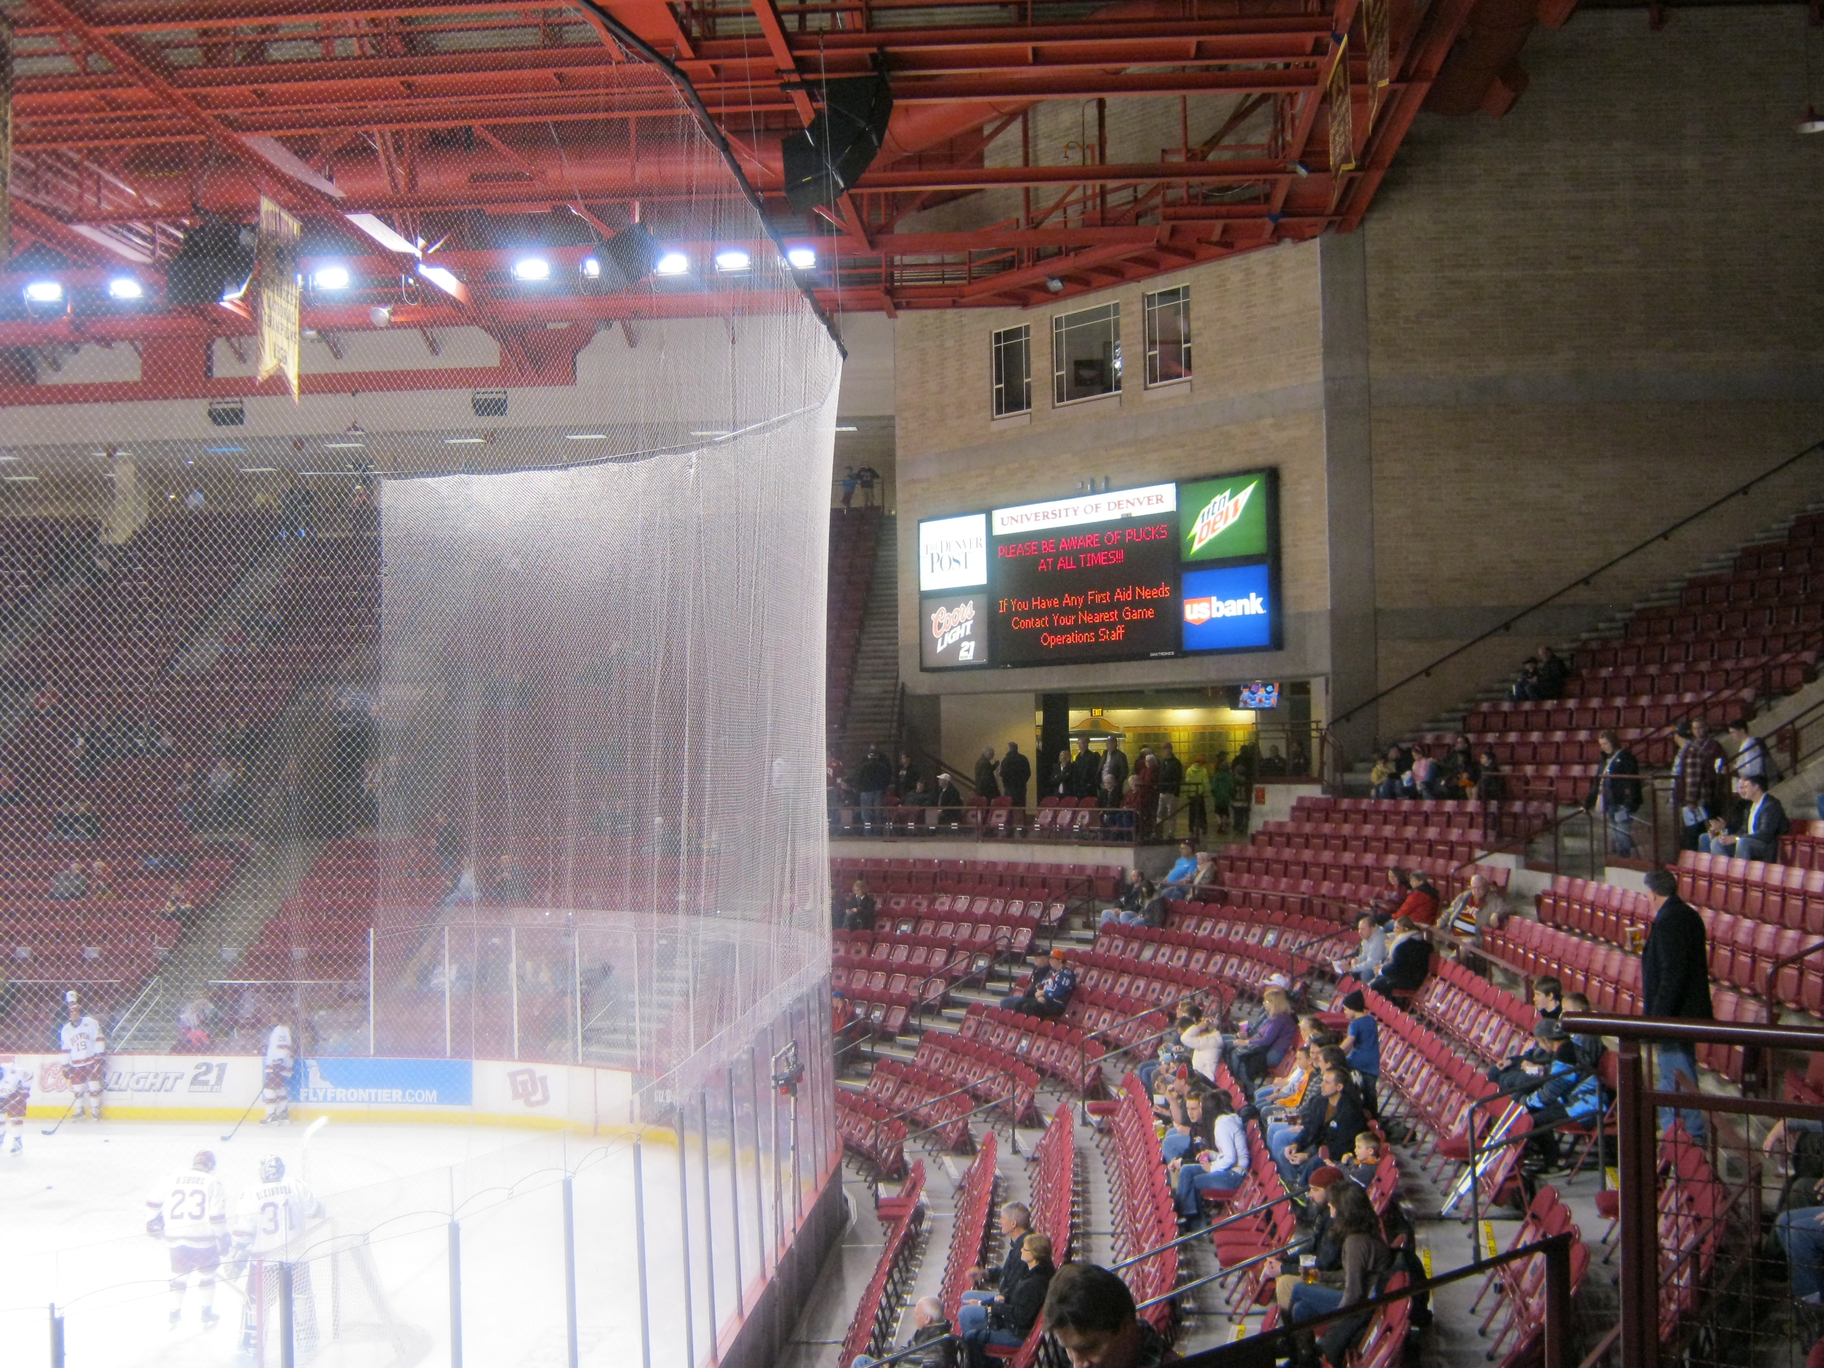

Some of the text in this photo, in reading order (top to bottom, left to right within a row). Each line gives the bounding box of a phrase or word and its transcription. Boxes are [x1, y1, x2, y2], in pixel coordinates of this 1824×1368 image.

[1000, 494, 1165, 526] UNIVERSITY OF DENVER
[998, 524, 1168, 558] PLEASE BE AWARE OF PUCKS
[930, 551, 970, 573] POST
[1038, 549, 1125, 572] AT ALL TIMES!!!
[998, 582, 1171, 613] If You Have Any First Aid Needs
[931, 600, 975, 638] Coors
[1011, 606, 1155, 630] Contact Your Nearest Game
[936, 620, 974, 654] LIGHT
[1040, 625, 1125, 648] Operations Staff
[960, 641, 976, 658] 21
[1092, 708, 1102, 717] EXIT
[76, 1040, 87, 1051] 19
[106, 1071, 184, 1092] LIGHT
[190, 1062, 228, 1087] 21
[301, 1088, 437, 1103] FLYFRONTIER.COM
[507, 1068, 551, 1108] DU
[170, 1189, 206, 1220] 23
[260, 1198, 296, 1235] 31
